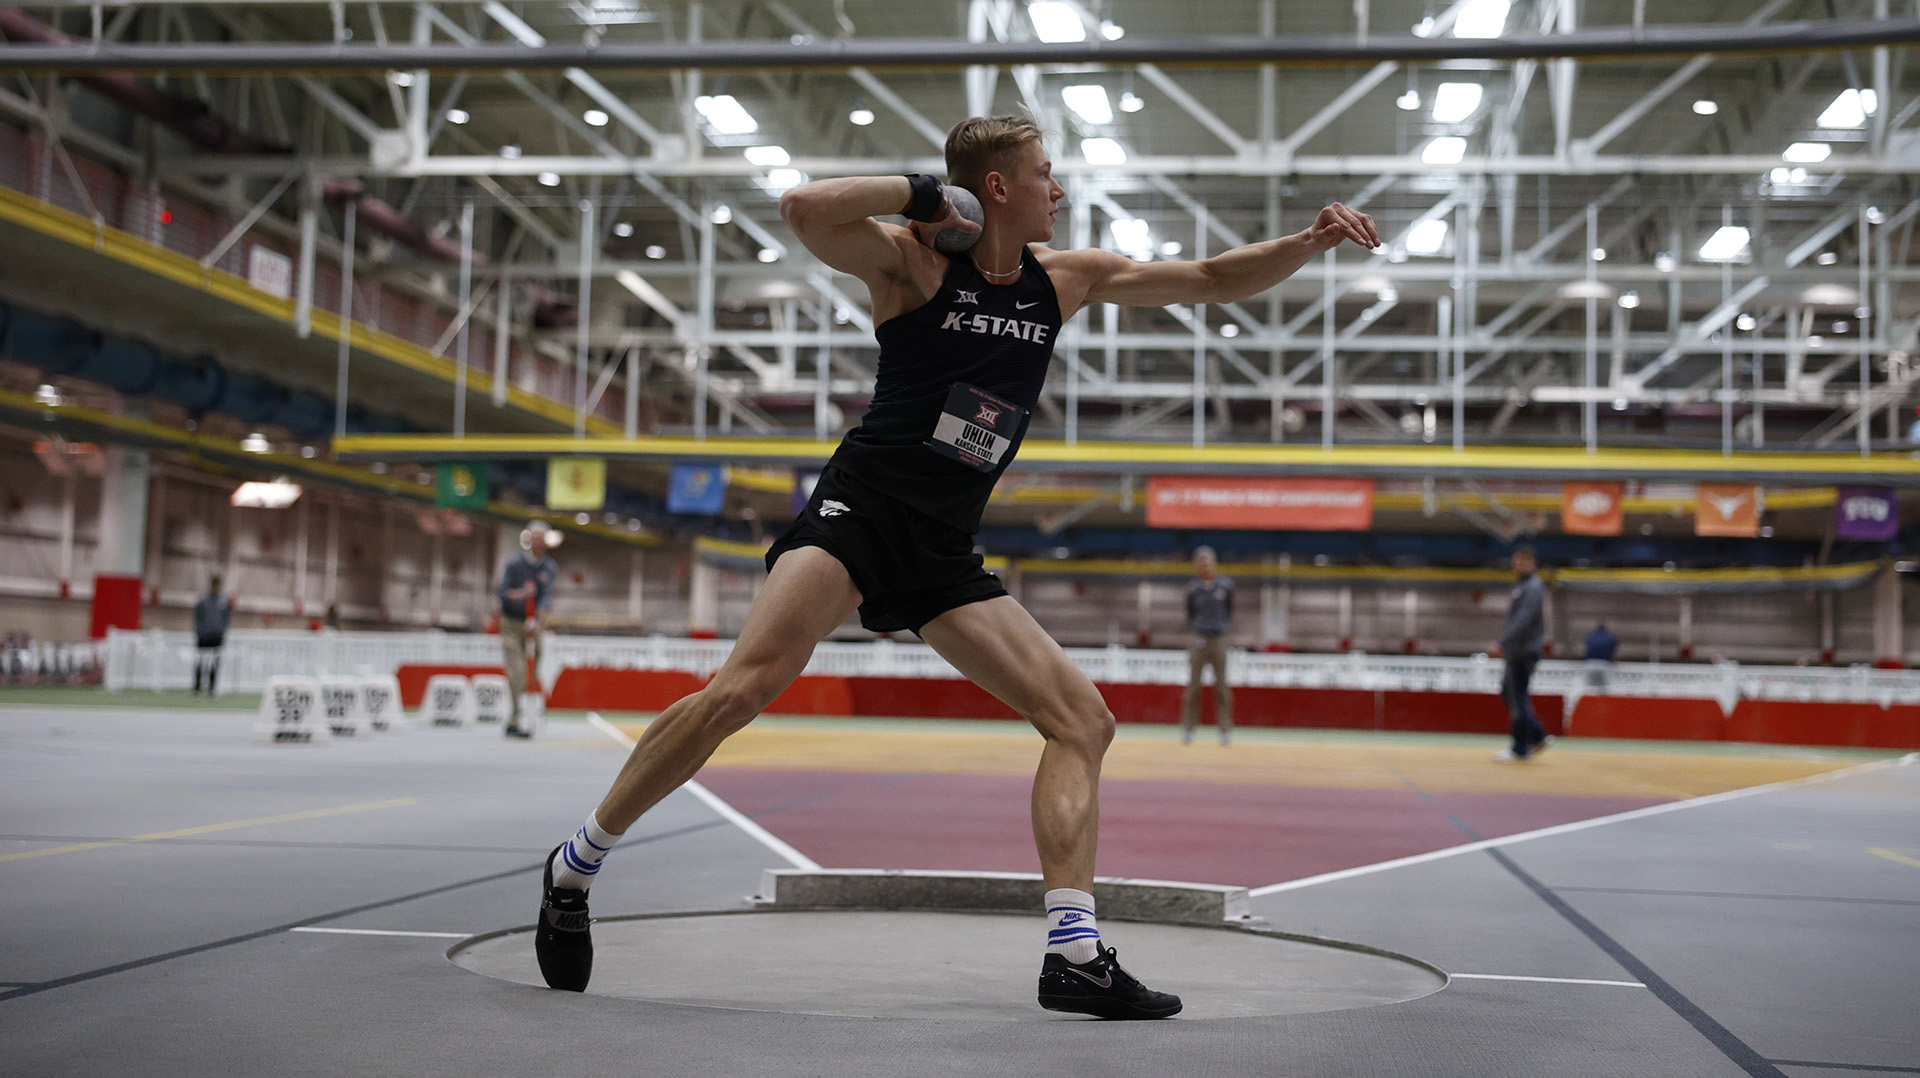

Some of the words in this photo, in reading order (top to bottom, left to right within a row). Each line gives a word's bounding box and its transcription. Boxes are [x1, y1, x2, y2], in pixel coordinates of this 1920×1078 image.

[941, 311, 1049, 344] K-STATE
[954, 437, 977, 454] KANSAS
[976, 447, 994, 461] STATE
[962, 423, 997, 450] UHLIN
[1064, 912, 1082, 920] NIKE
